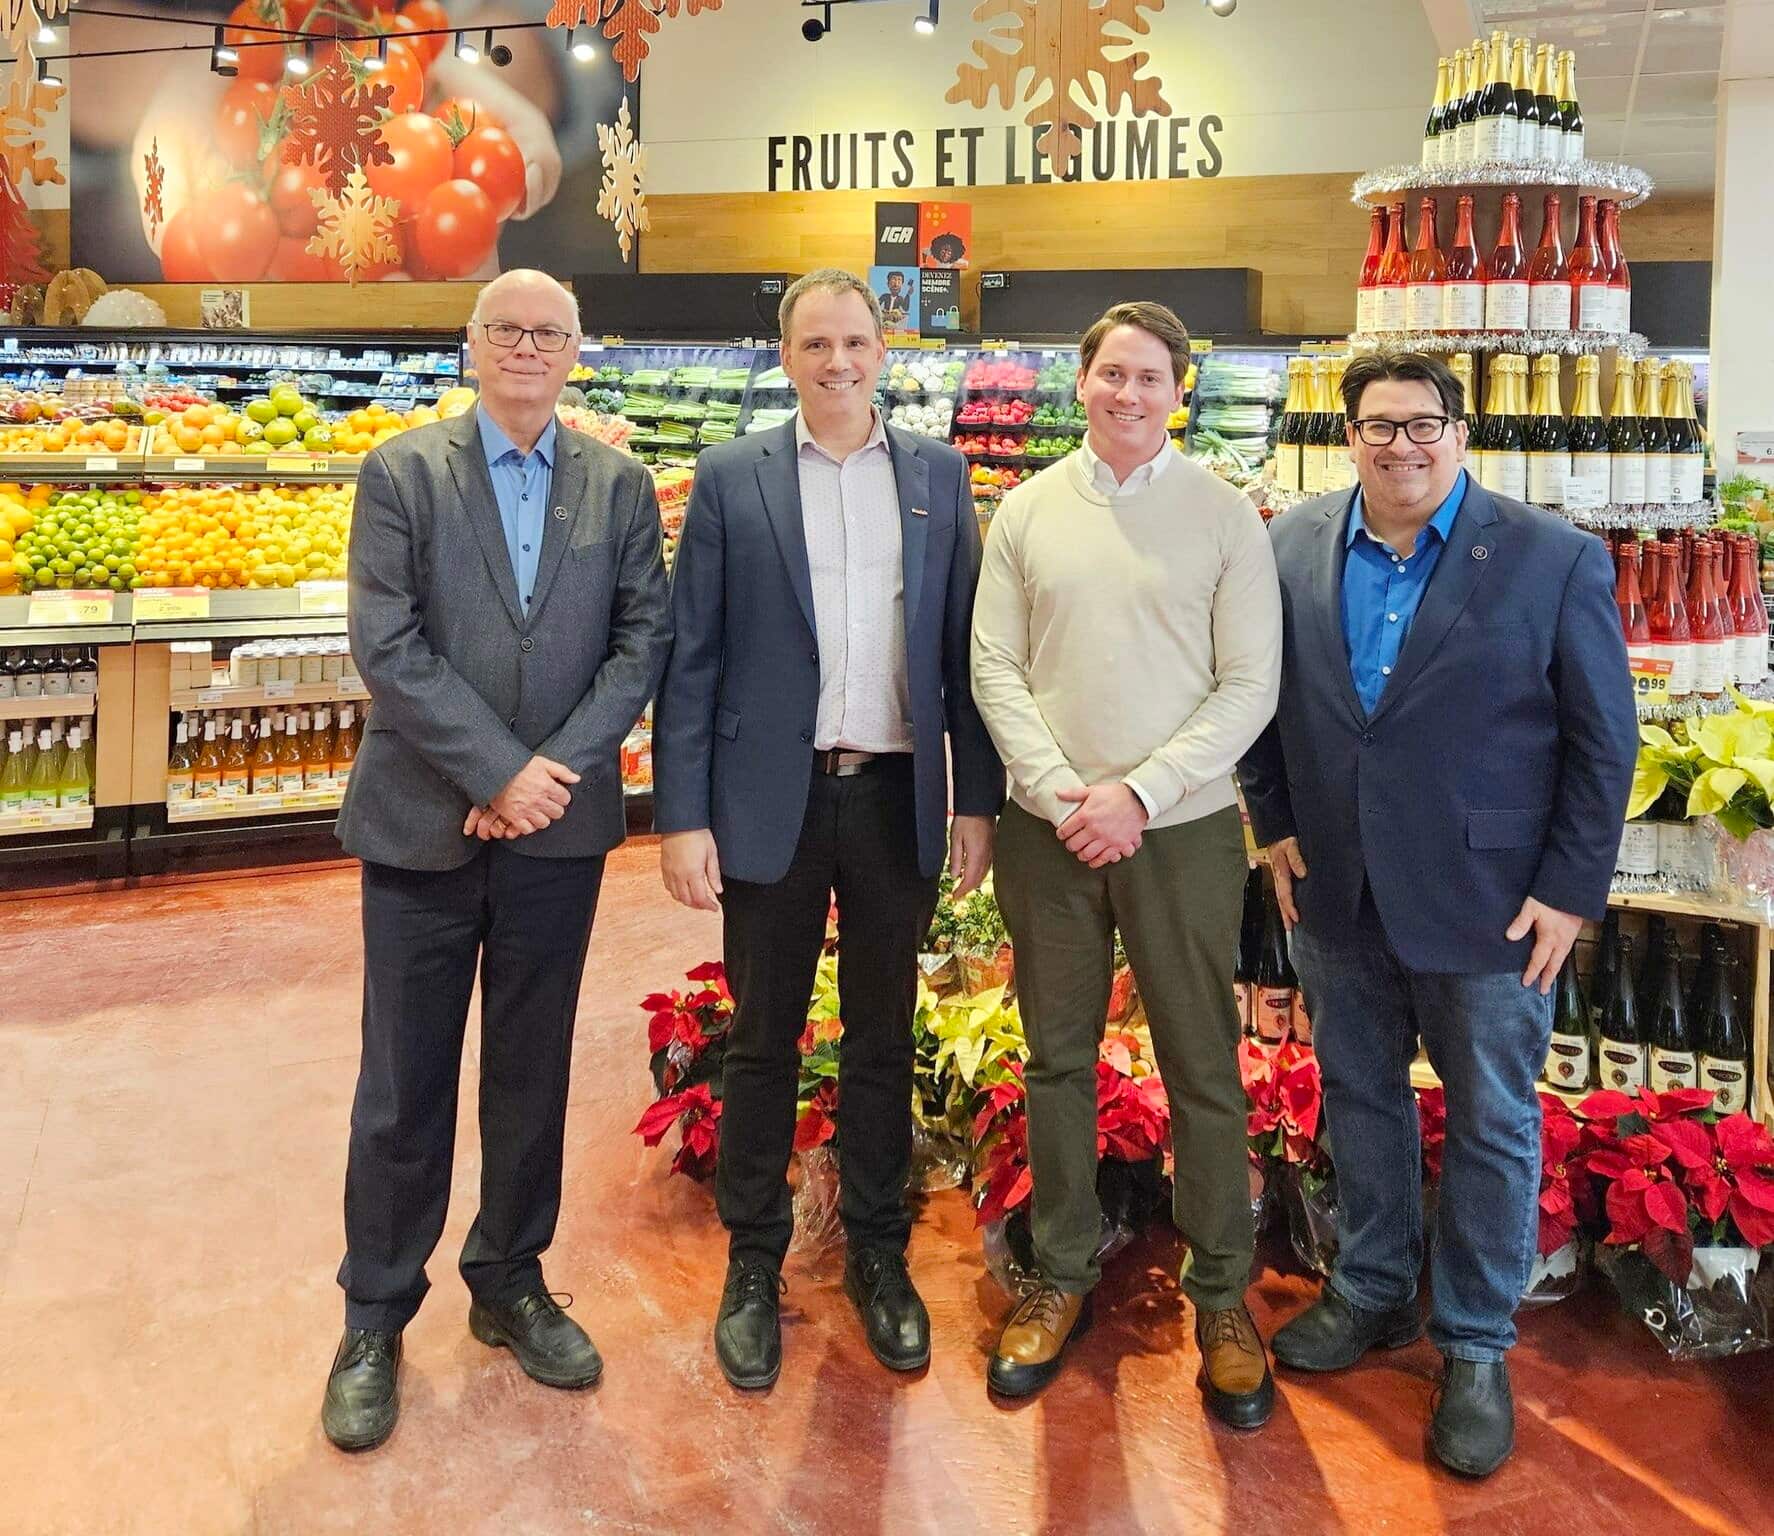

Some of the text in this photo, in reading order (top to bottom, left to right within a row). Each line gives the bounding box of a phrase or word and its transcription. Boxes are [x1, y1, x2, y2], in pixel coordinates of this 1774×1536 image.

[768, 129, 915, 191] FRUITS
[936, 127, 984, 187] ET
[881, 226, 914, 243] IGA
